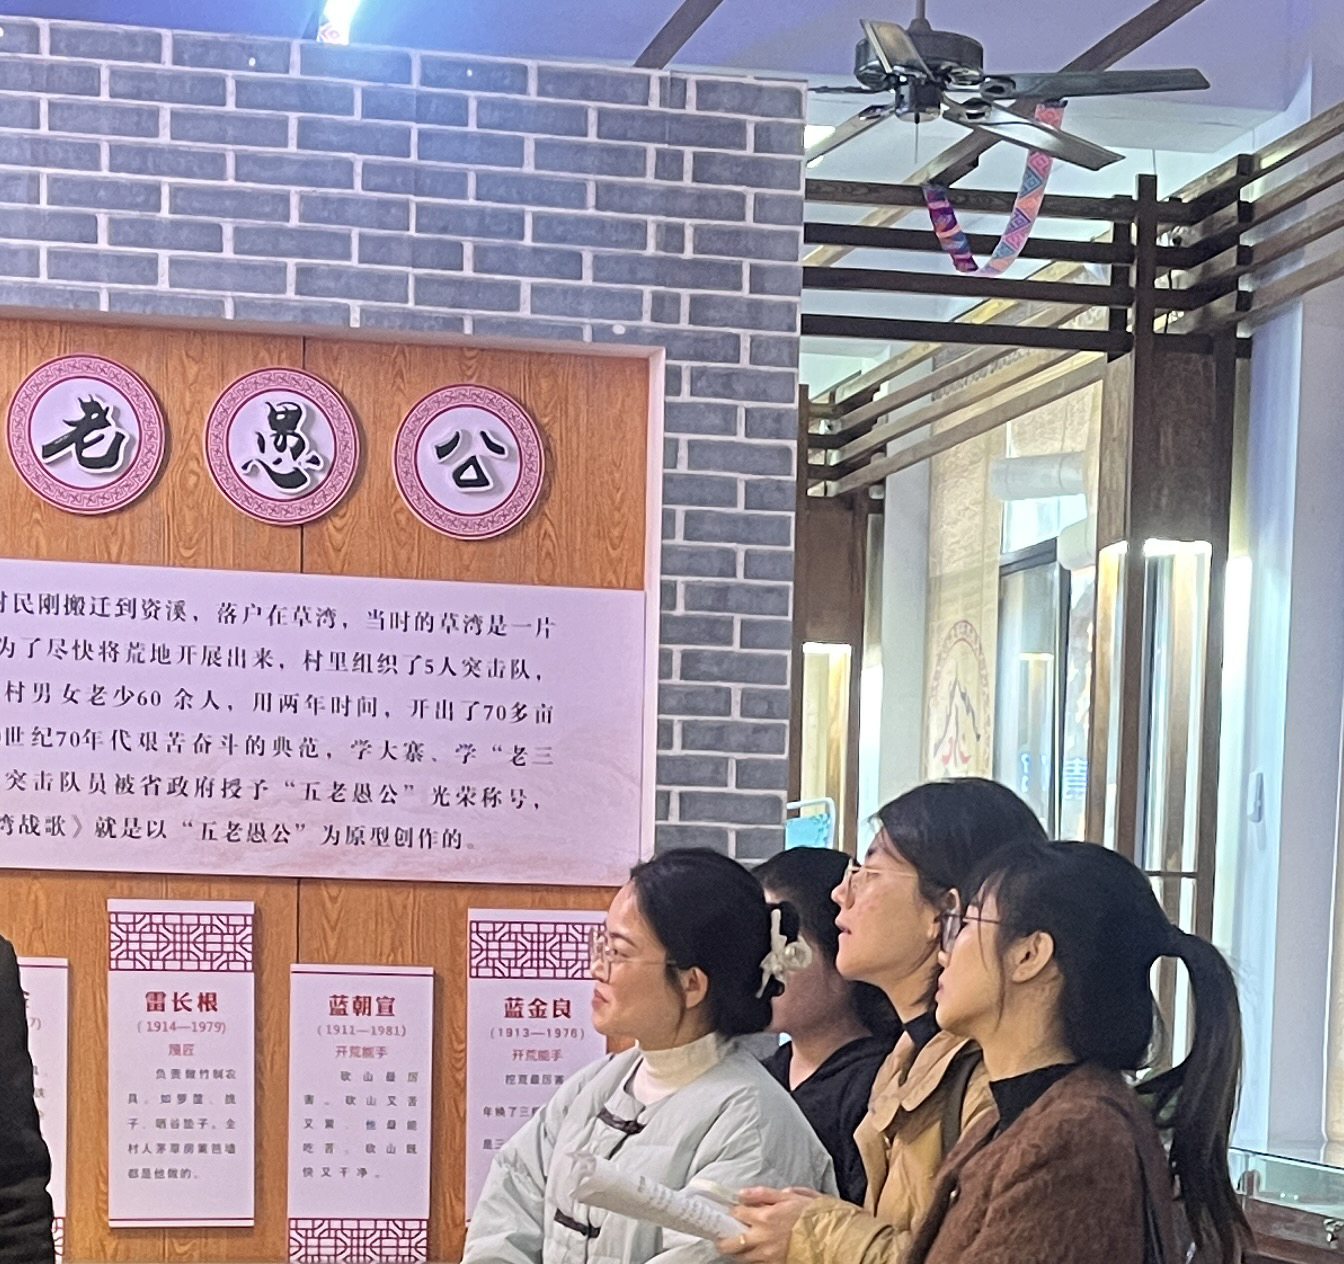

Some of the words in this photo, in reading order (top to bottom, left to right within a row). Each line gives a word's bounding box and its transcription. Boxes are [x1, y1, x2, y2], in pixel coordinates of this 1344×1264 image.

[146, 991, 218, 1012] 雷长根
[329, 995, 395, 1016] 蓝朝宣
[504, 997, 571, 1019] 蓝金良
[336, 1046, 388, 1058] 开荒能手
[512, 1049, 563, 1061] 开荒能手
